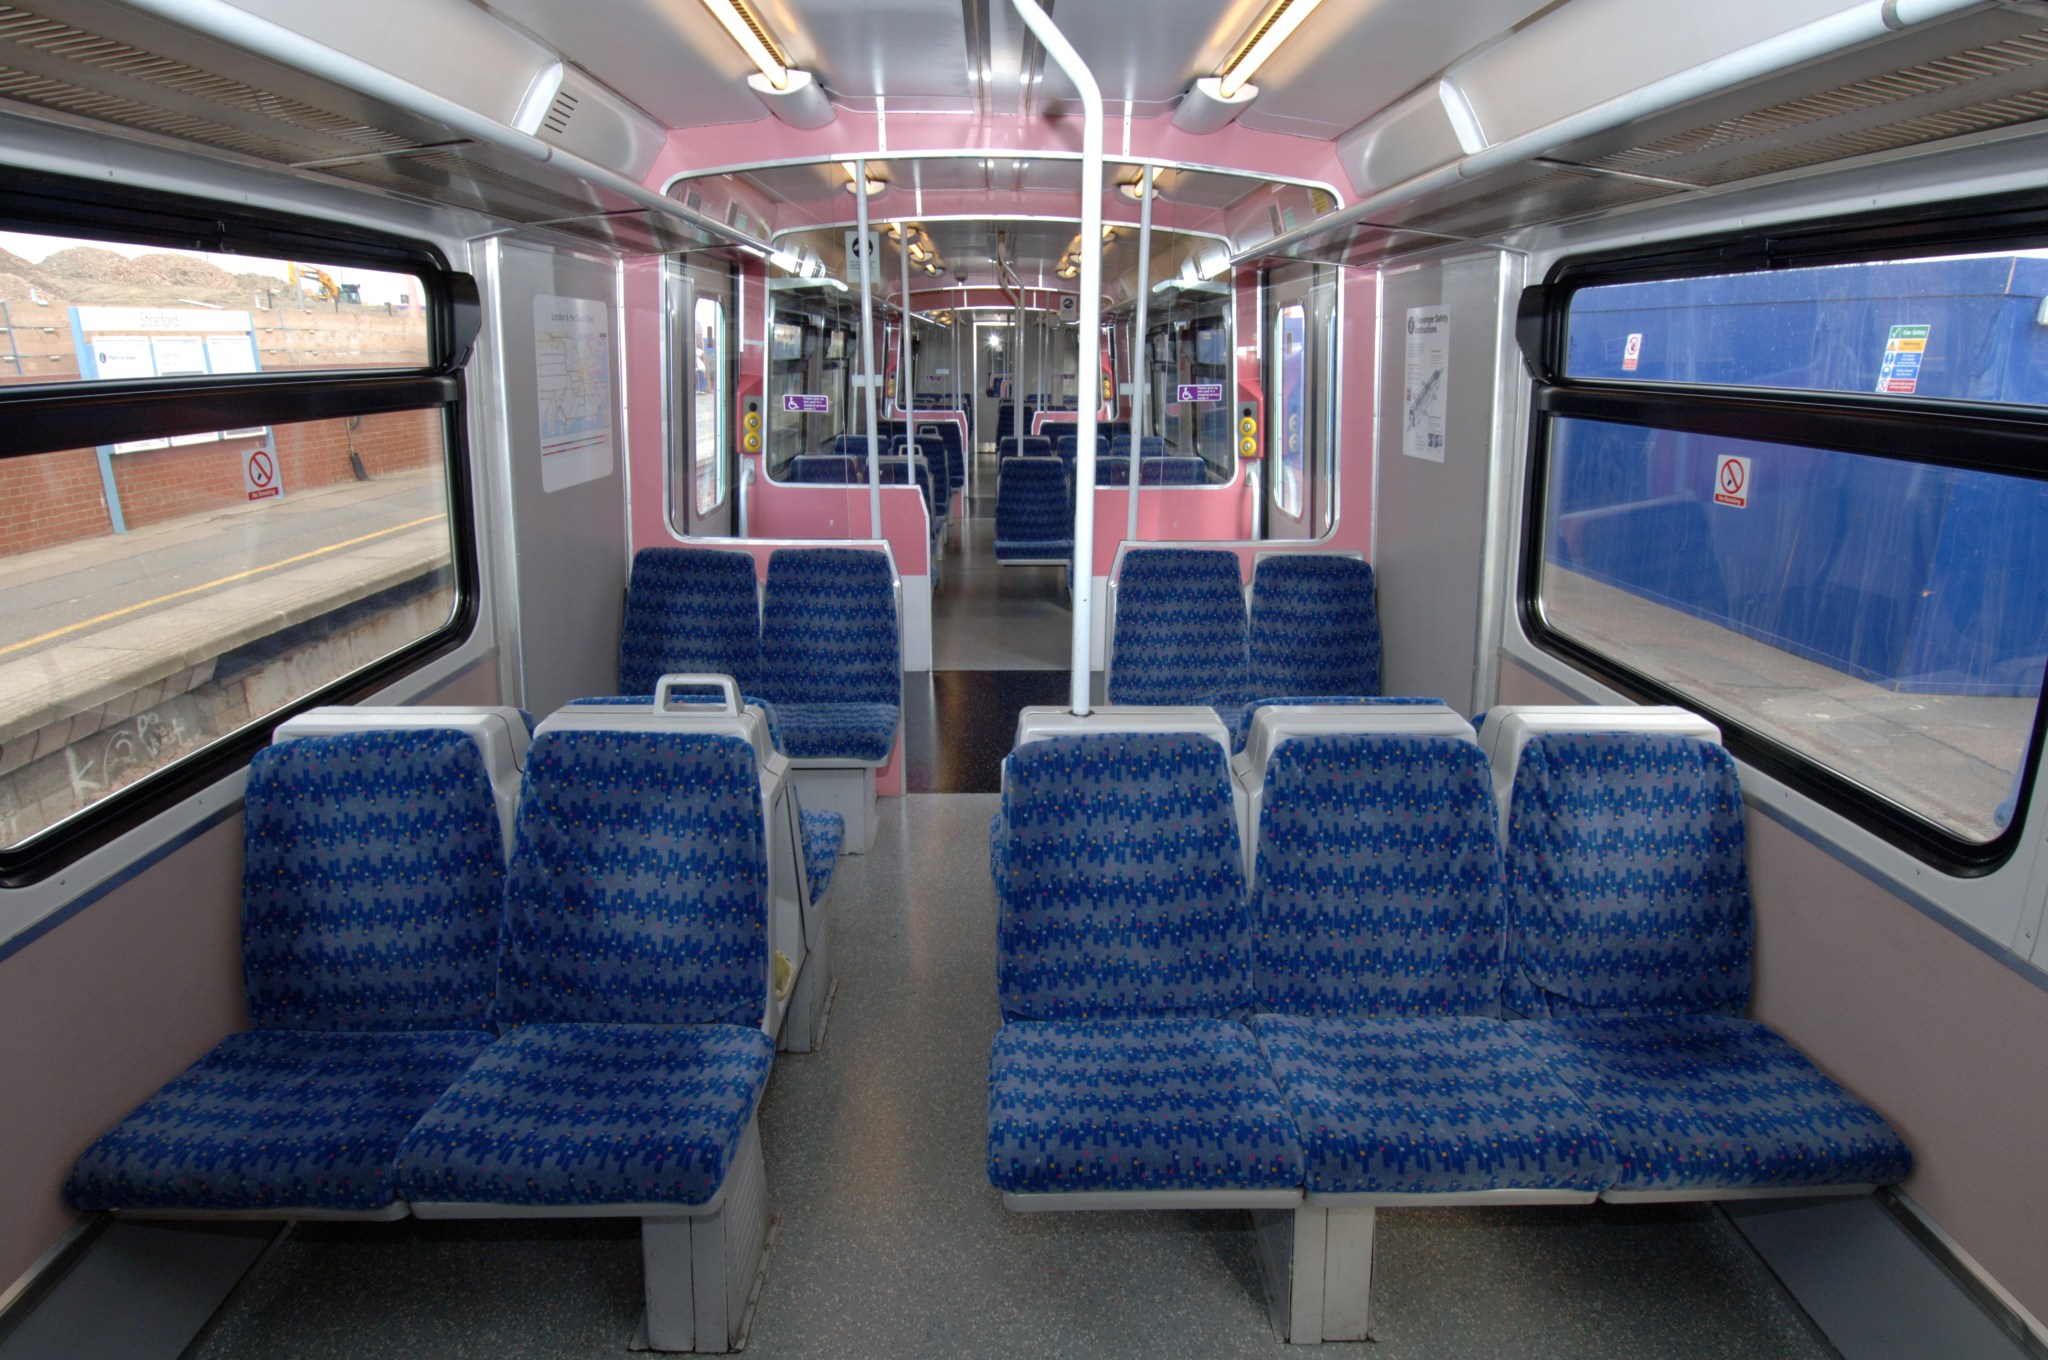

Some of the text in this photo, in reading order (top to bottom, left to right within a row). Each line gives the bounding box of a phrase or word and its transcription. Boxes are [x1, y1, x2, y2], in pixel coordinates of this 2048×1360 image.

[139, 312, 178, 328] Stratford
[551, 312, 565, 321] London
[1435, 314, 1448, 325] Safety
[1912, 329, 1926, 337] Safety
[260, 489, 276, 498] Smoking
[1725, 496, 1741, 505] Smoking
